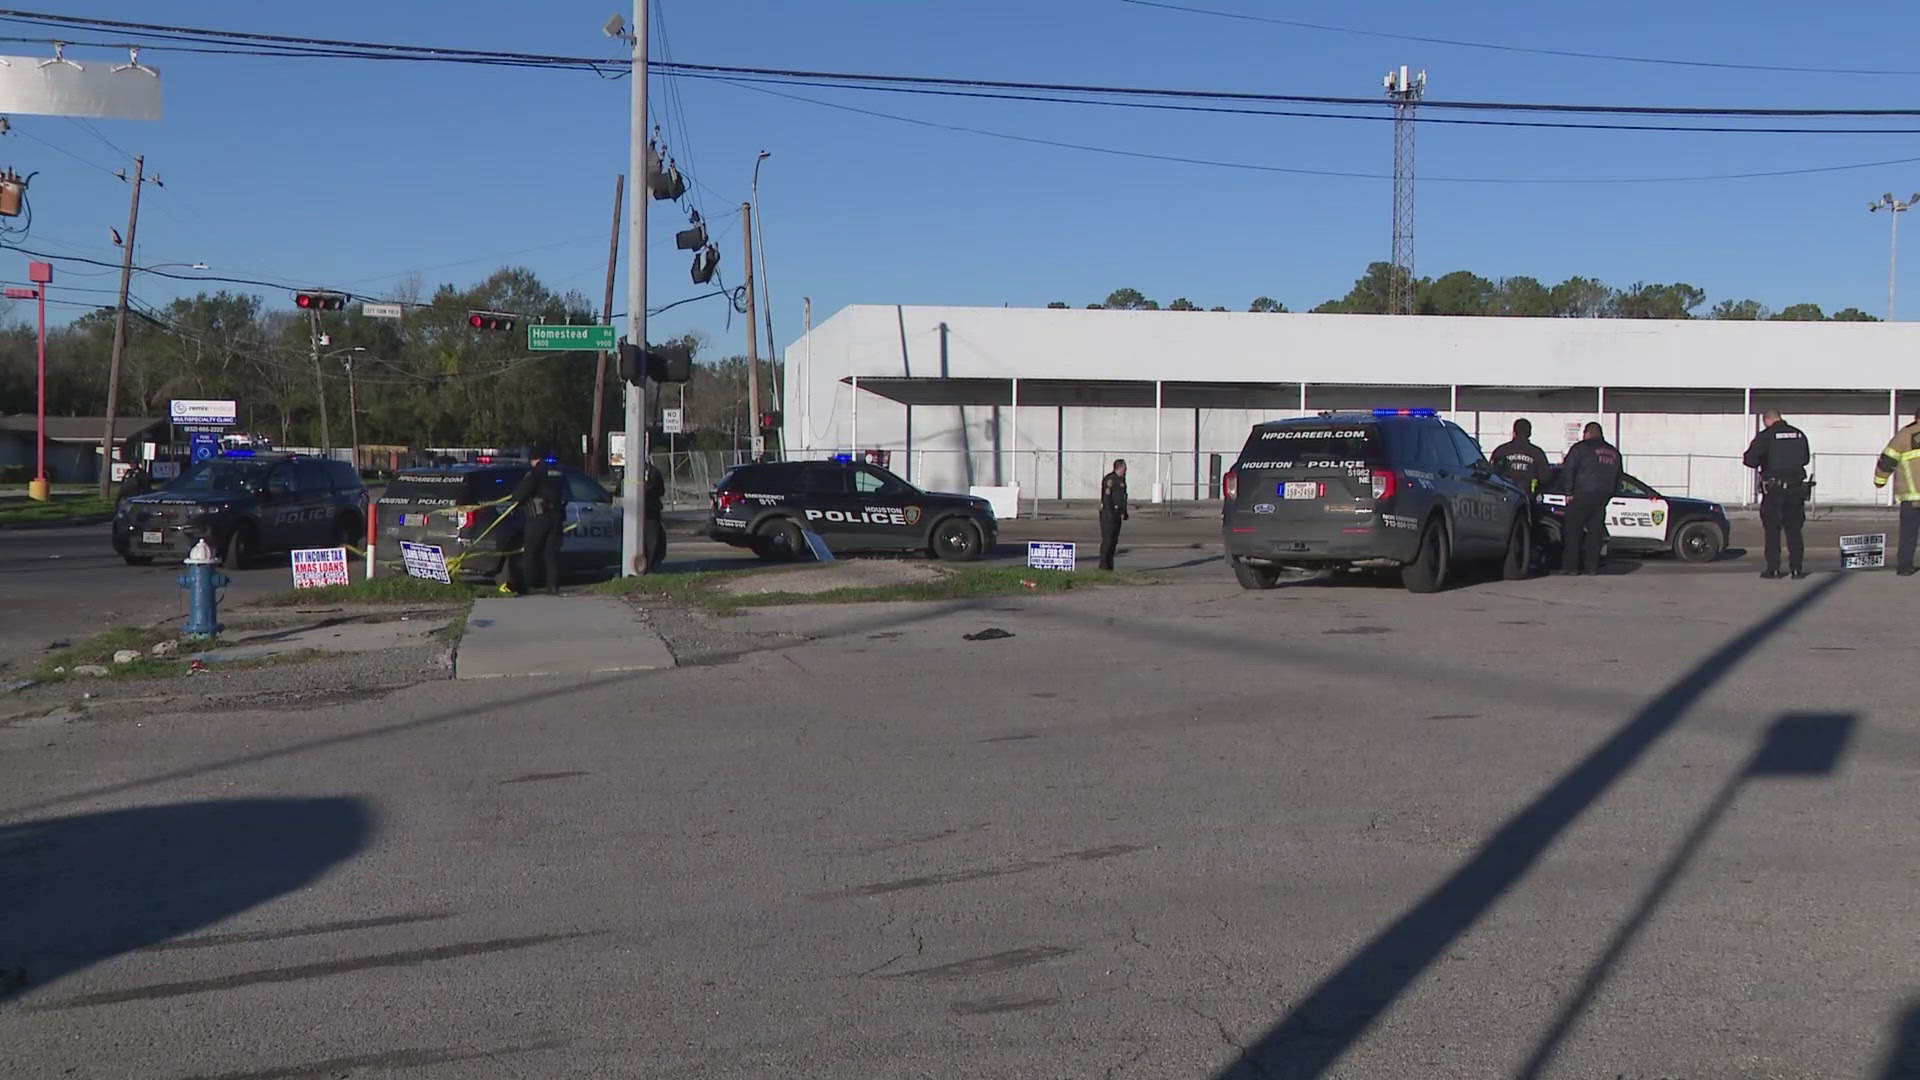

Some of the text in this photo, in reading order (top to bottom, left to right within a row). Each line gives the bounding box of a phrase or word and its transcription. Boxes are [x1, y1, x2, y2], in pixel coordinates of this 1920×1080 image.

[532, 328, 588, 339] Homestead
[1261, 430, 1366, 440] HPDCAREER.COM
[1241, 460, 1365, 469] HOUSTON POLICE
[398, 475, 465, 483] HPDCAREER.COM
[417, 498, 457, 506] POLICE
[744, 493, 785, 501] EMERGENCY
[864, 506, 903, 514] HOUSTON
[1453, 497, 1498, 520] POLICE
[274, 508, 336, 526] POLICE
[804, 509, 907, 525] POLICE
[1604, 516, 1653, 527] LICE
[294, 550, 343, 562] MY INCOME TAX
[404, 548, 442, 563] LAND FOR SALE
[1031, 547, 1073, 558] LAND FOR SALE
[295, 562, 344, 573] XMAS LOANS
